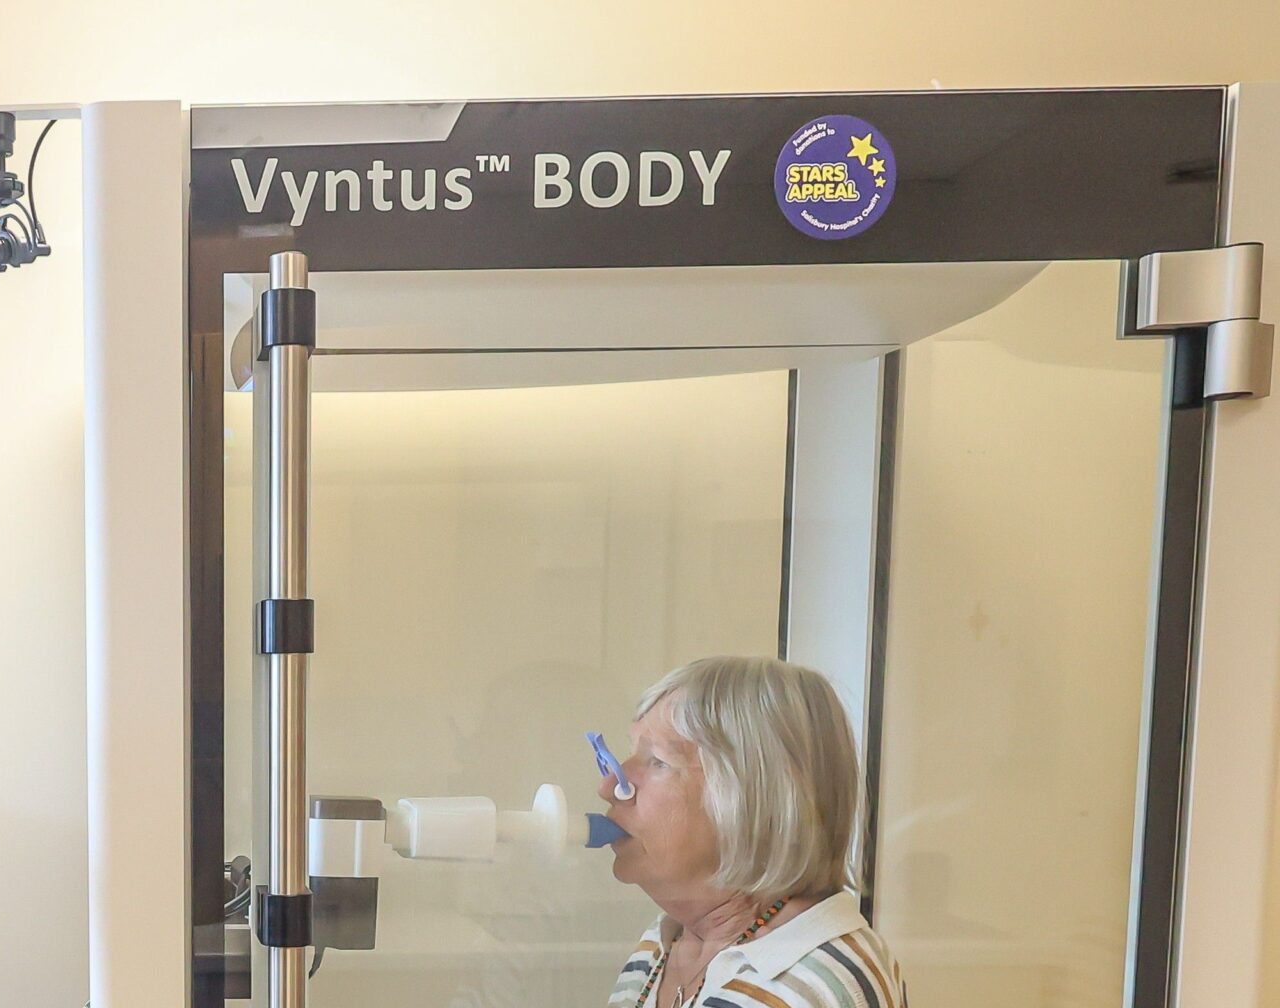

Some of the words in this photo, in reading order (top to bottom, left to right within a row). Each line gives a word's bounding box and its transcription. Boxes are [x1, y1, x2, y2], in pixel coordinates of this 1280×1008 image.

[793, 125, 818, 147] Funded
[817, 122, 827, 131] by
[795, 132, 827, 155] donations
[827, 128, 836, 136] to
[534, 149, 732, 209] BODY
[788, 165, 846, 182] STARS
[788, 183, 858, 200] APPEAL
[801, 210, 830, 231] Salisbury
[861, 193, 881, 217] Charity
